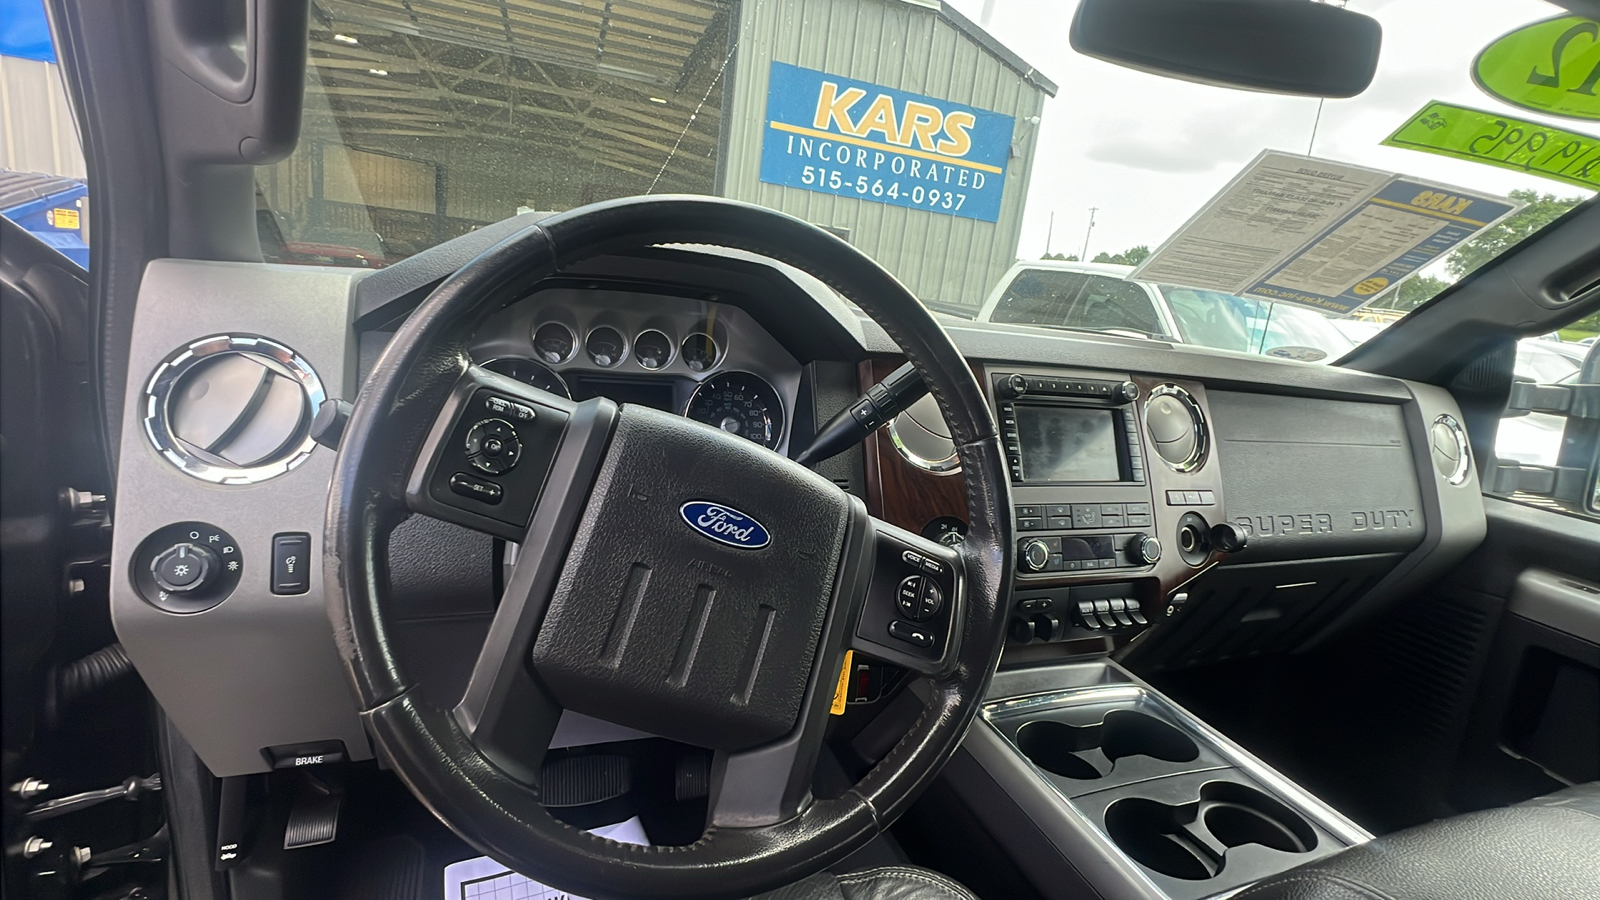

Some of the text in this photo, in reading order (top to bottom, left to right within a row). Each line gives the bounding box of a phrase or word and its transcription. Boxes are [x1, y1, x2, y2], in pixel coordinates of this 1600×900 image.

[813, 81, 976, 157] KARS
[787, 135, 986, 190] INCORPORATED
[801, 166, 967, 212] 515-564-0937
[697, 505, 754, 542] Ford
[1235, 509, 1415, 538] SUPER DUTY
[907, 553, 921, 563] VOICE
[295, 755, 324, 766] BRAKE
